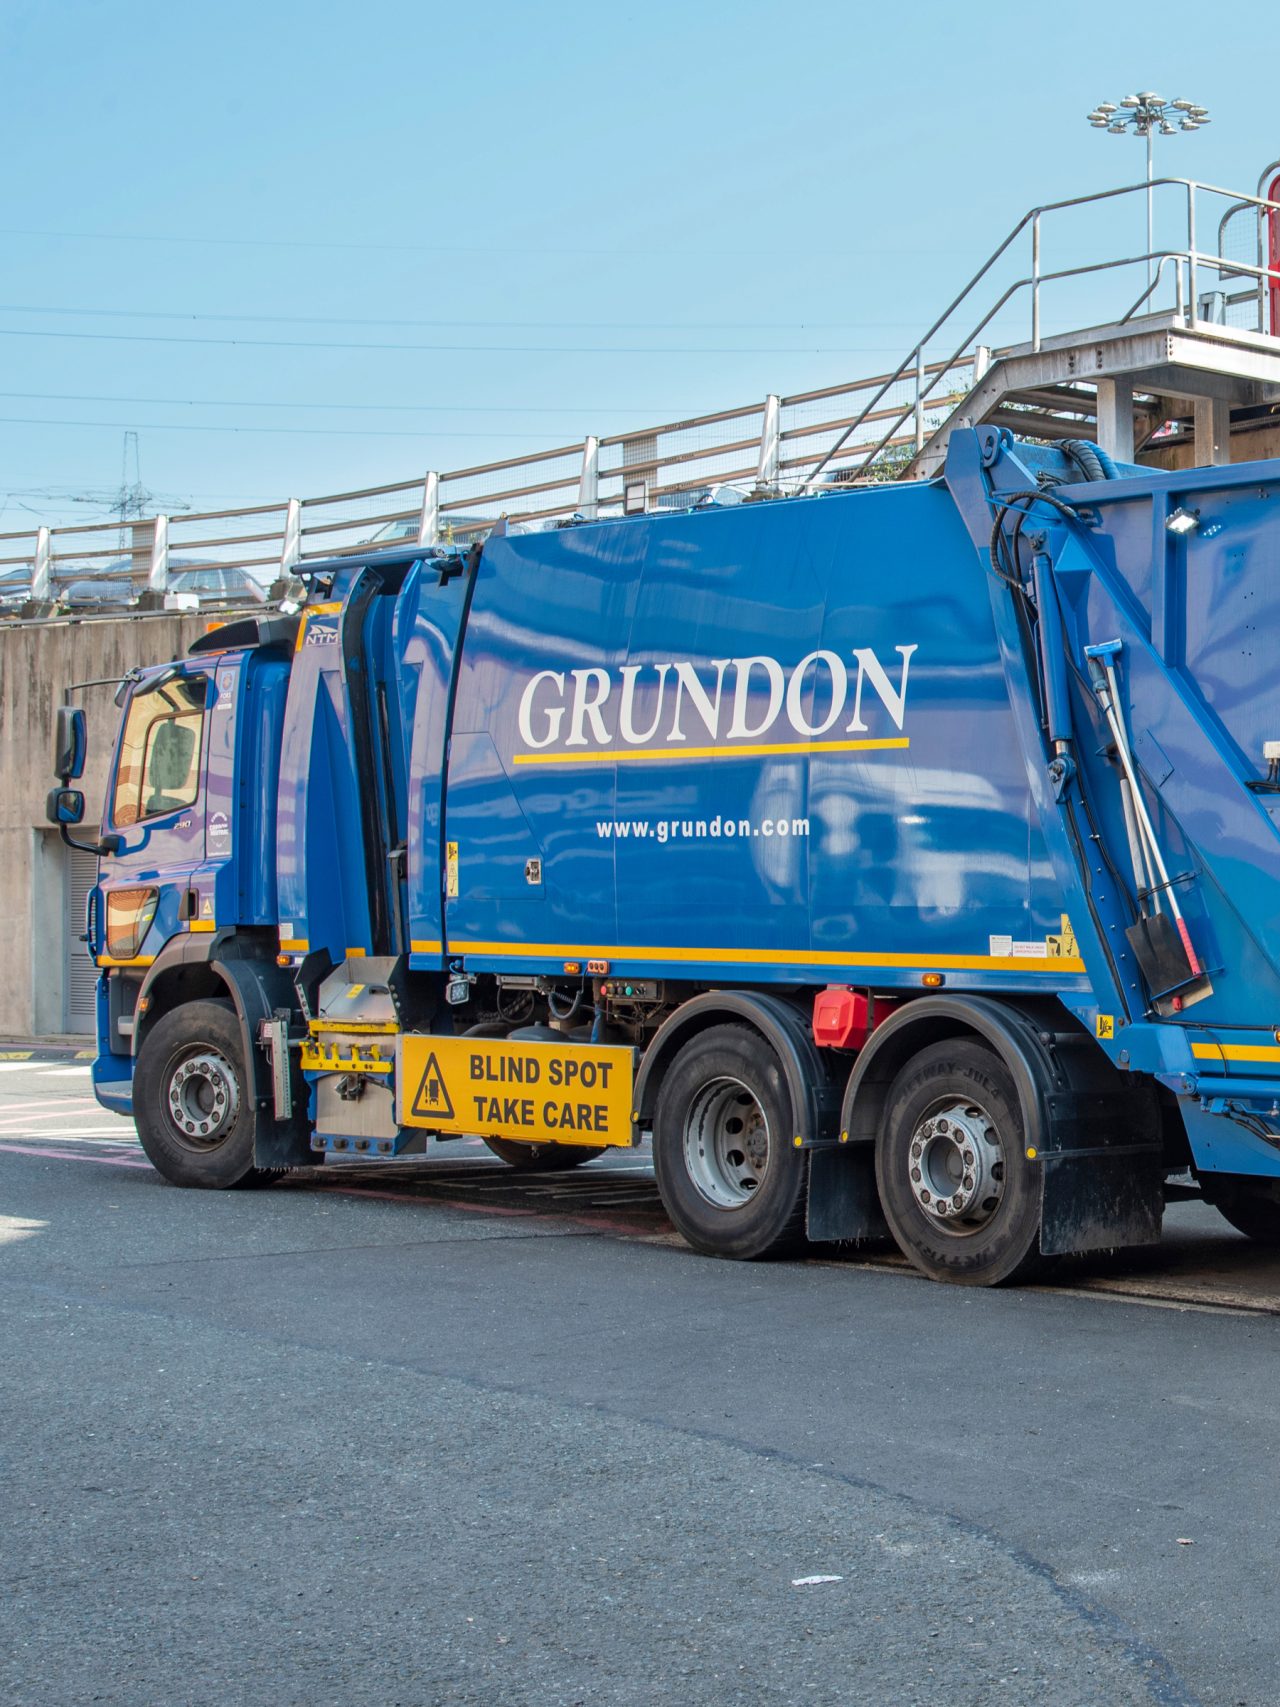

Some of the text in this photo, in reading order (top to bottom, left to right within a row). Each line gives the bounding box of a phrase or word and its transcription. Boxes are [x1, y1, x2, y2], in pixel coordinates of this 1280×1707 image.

[306, 633, 338, 645] NTM
[518, 644, 918, 748] GRUNDON
[596, 815, 811, 843] www.grundon.com
[470, 1054, 613, 1089] BLIND SPOT
[473, 1096, 609, 1132] TAKE CARE
